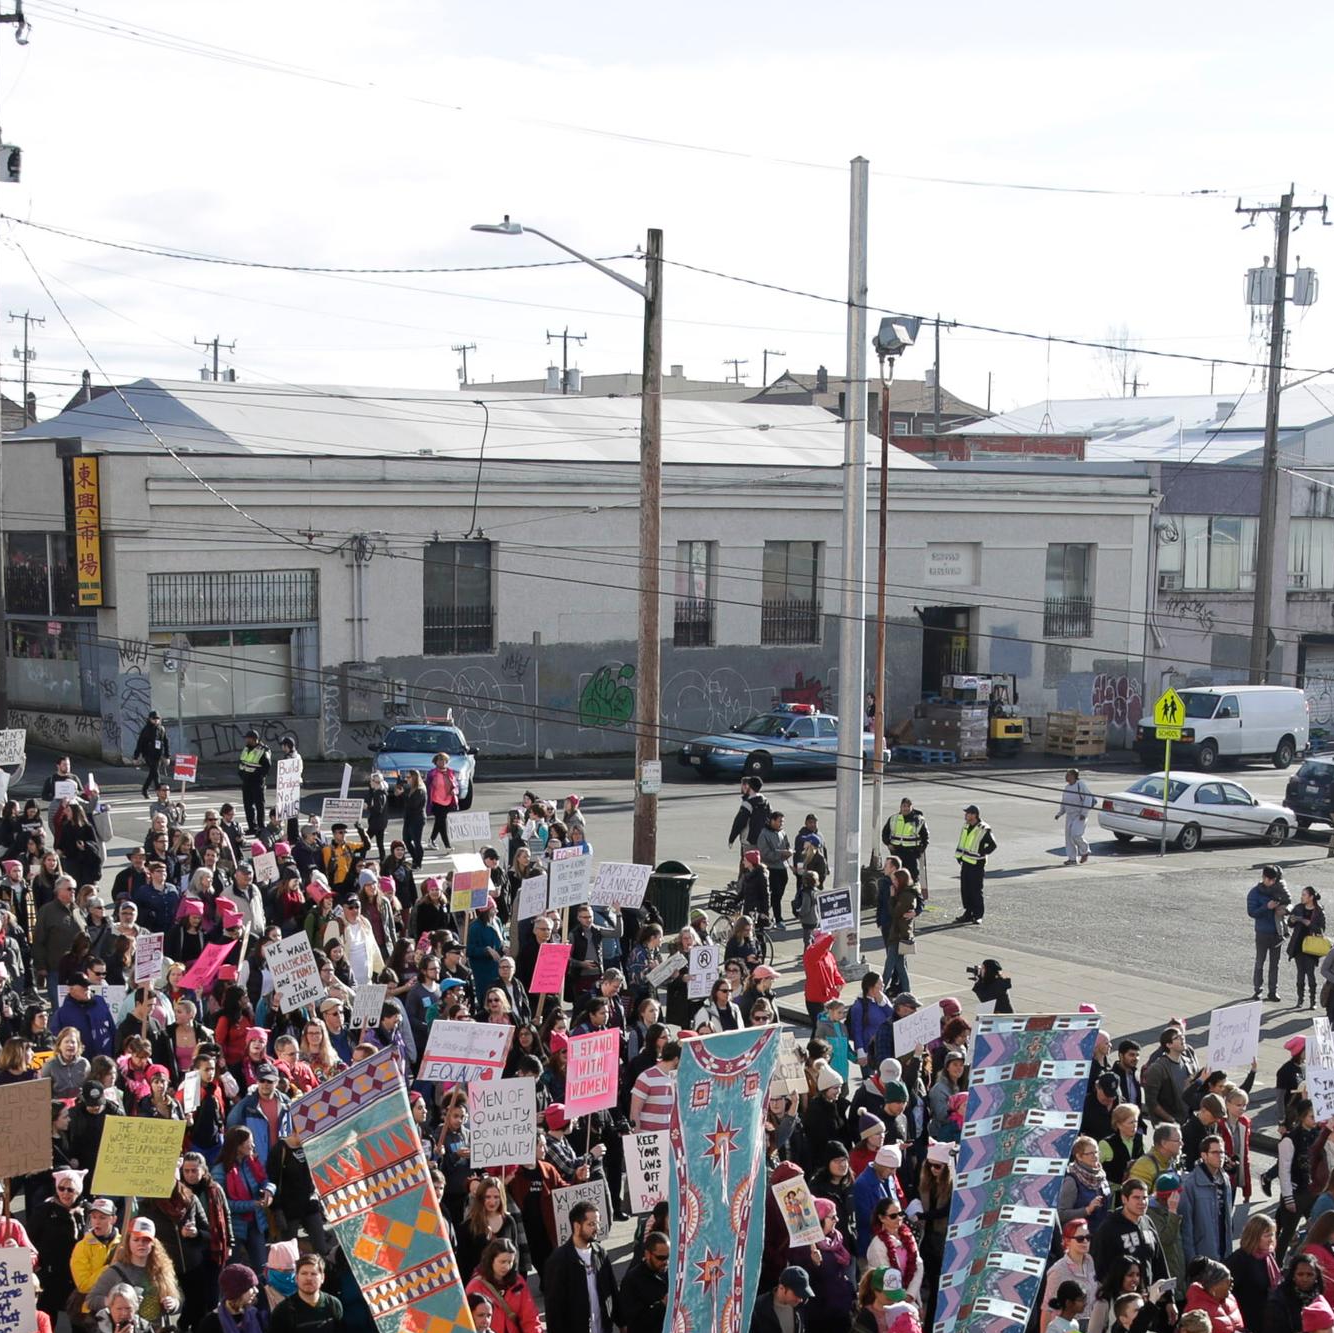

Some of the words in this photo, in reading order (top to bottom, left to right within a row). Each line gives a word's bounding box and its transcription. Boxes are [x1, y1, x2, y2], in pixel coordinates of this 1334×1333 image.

[75, 462, 99, 578] 東興市場
[1158, 729, 1180, 738] SCHOOL
[628, 866, 647, 877] FOR
[595, 877, 643, 891] PLANNED
[267, 944, 282, 957] WE
[286, 941, 308, 956] WANT
[273, 955, 313, 975] HEALTHCARE
[276, 974, 291, 988] and
[293, 979, 308, 992] TAX
[287, 986, 318, 1007] RETURNS
[580, 1041, 612, 1057] STAND
[578, 1061, 603, 1076] WITH
[570, 1082, 608, 1096] WOMEN
[471, 1092, 503, 1109] MEN
[508, 1088, 524, 1103] OF
[473, 1108, 530, 1128] QUALITY
[473, 1129, 489, 1140] DO
[492, 1126, 510, 1137] NOT
[512, 1123, 533, 1136] FEAR
[636, 1134, 659, 1146] KEEP
[473, 1138, 535, 1163] EQUALITY!
[637, 1147, 660, 1158] YOUR
[640, 1159, 662, 1170] LAWS
[643, 1171, 661, 1182] OFF
[648, 1183, 659, 1194] MY
[11, 1271, 28, 1284] the
